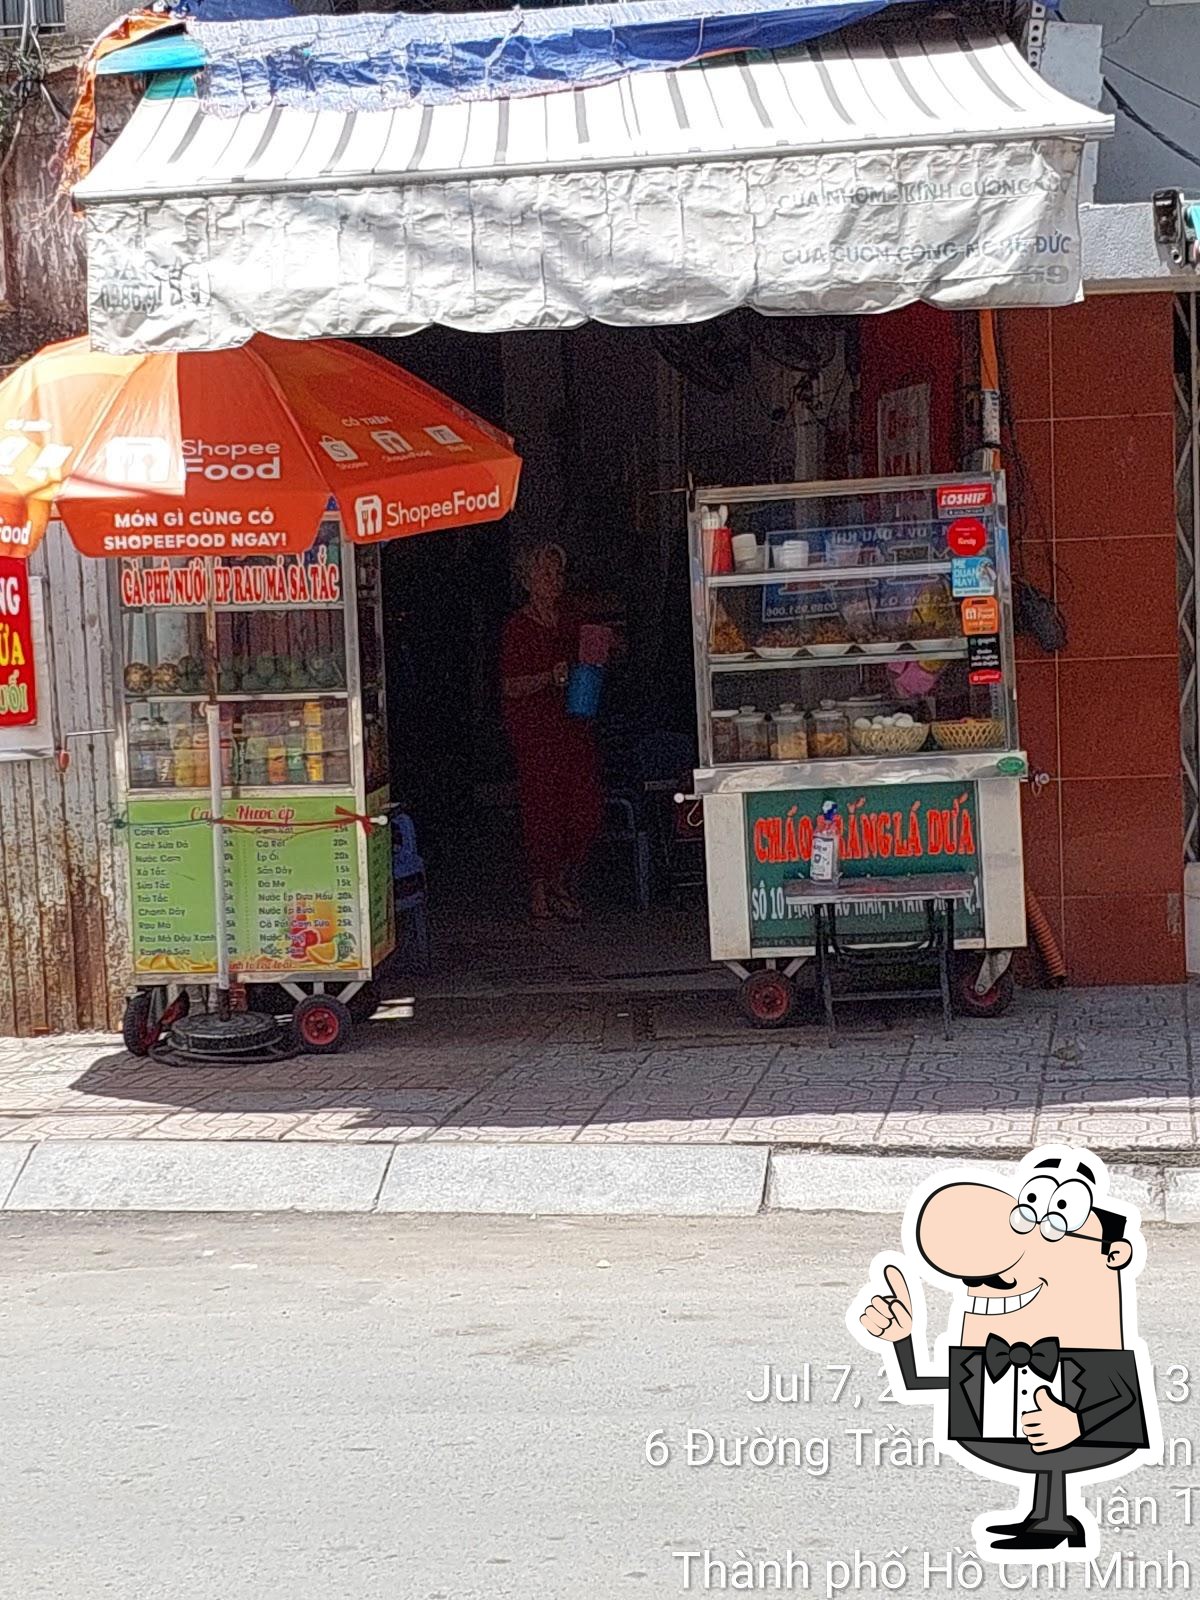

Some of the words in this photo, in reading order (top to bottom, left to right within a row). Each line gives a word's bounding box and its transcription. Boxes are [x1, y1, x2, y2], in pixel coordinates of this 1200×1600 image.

[1035, 229, 1072, 254] ĐỨC
[181, 439, 281, 460] Shopee
[184, 456, 281, 480] Food
[386, 485, 501, 528] ShopeeFood
[940, 492, 987, 506] LOSHIP
[114, 509, 158, 528] MÓN
[163, 509, 184, 527] GÌ
[189, 508, 243, 526] CÙNG
[248, 506, 275, 525] CÓ
[103, 533, 226, 551] SHOPEEFOOD
[231, 532, 287, 547] NGAY!
[143, 556, 172, 605] PHÊ
[232, 566, 263, 604] RAU
[754, 804, 815, 864] CHÁO
[892, 800, 923, 858] LÁ
[336, 864, 350, 873] 15k
[770, 886, 785, 920] 10
